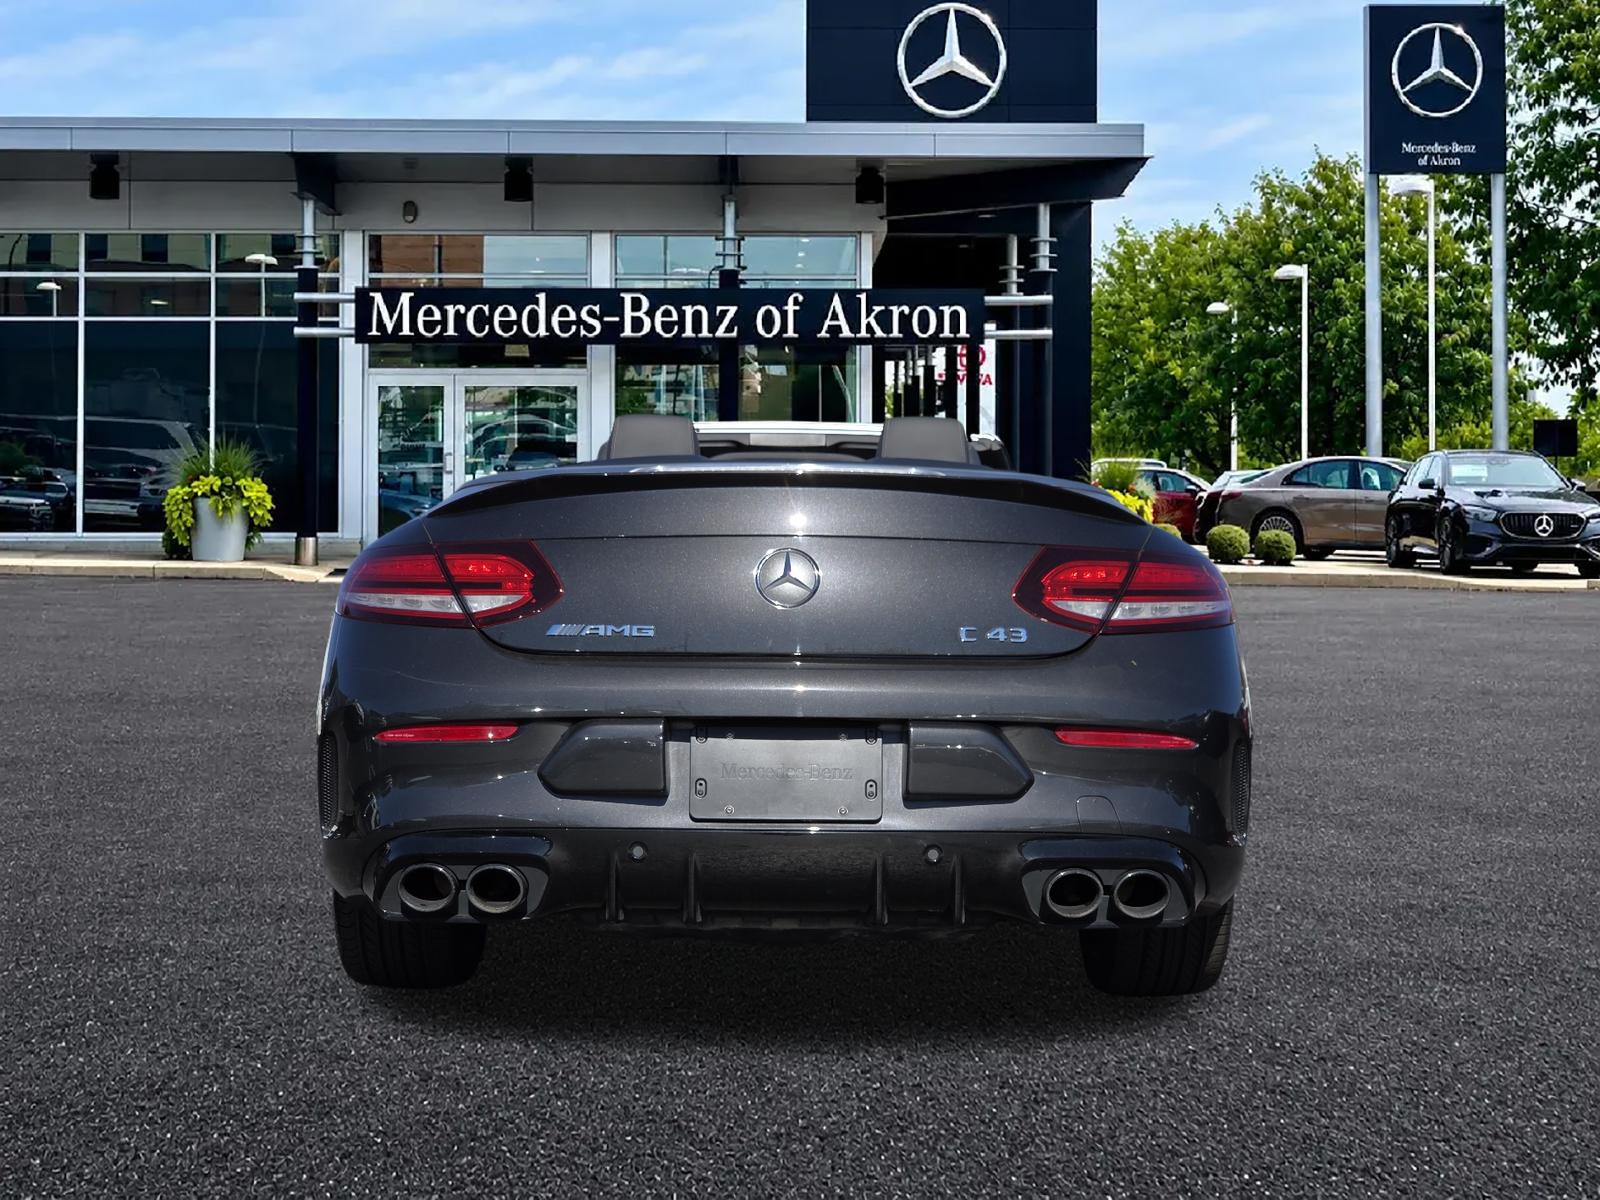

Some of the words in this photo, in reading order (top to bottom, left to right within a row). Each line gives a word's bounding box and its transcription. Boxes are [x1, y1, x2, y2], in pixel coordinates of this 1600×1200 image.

[1401, 142, 1476, 153] Mercedes-Benz
[1417, 154, 1428, 166] of
[1430, 154, 1461, 166] Akron
[367, 291, 738, 338] Mercedes-Benz
[755, 292, 803, 338] of
[817, 292, 970, 338] Akron
[580, 624, 655, 637] AMG
[960, 627, 977, 642] C
[985, 627, 1028, 643] 43
[719, 761, 853, 780] Mercedes-Benz
